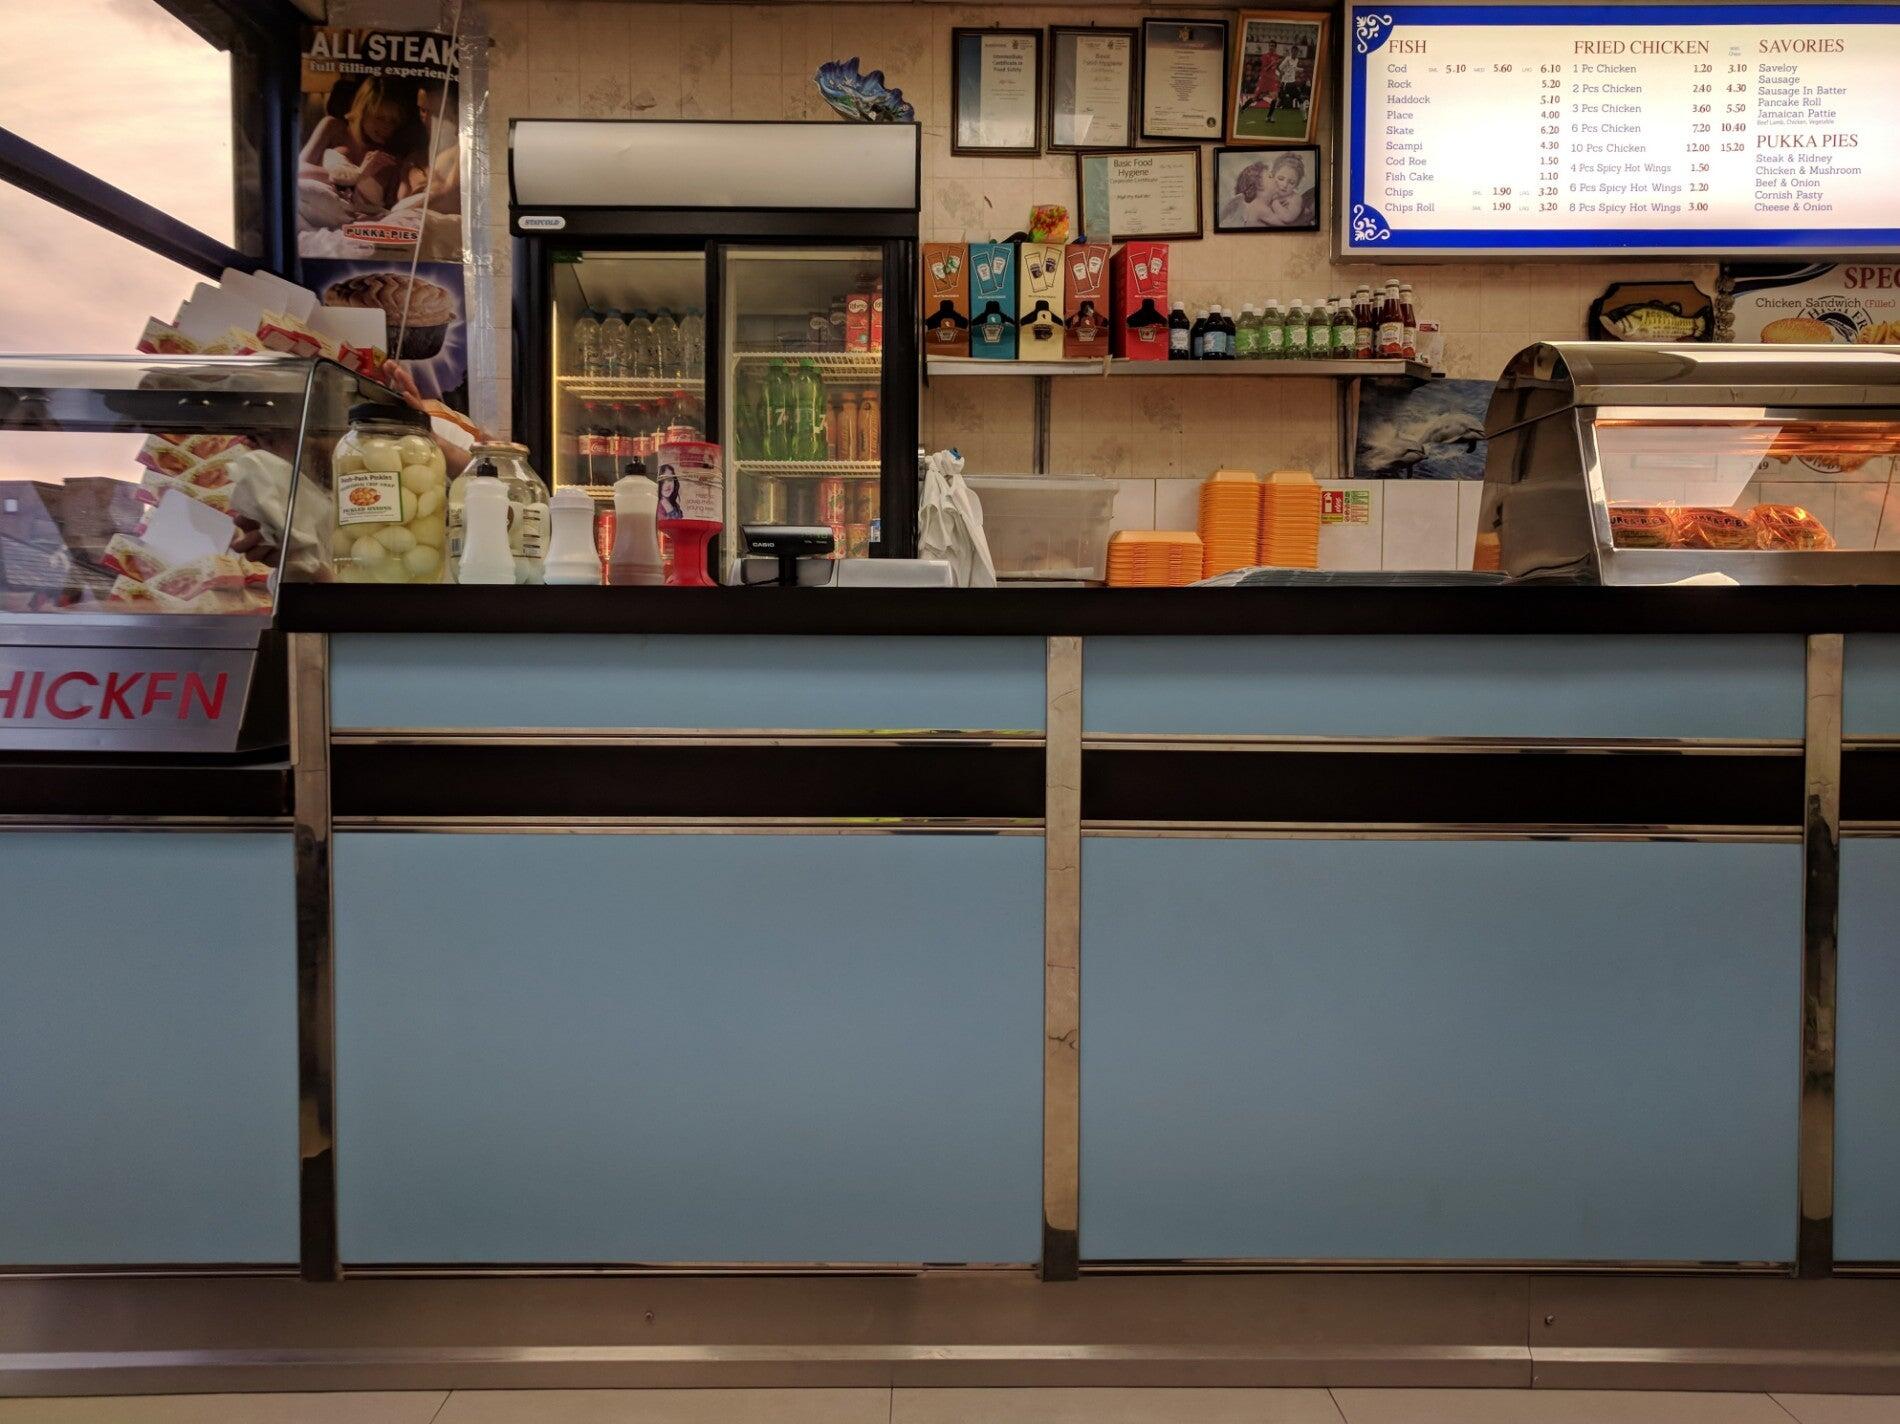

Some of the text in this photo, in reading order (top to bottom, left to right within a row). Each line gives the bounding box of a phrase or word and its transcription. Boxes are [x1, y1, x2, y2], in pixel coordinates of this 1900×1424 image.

[310, 32, 459, 68] ALL STEAK
[1388, 39, 1426, 53] FISH
[1575, 41, 1709, 54] FRIED CHICKEN
[1760, 39, 1844, 53] SAVORIES
[310, 60, 336, 72] full
[339, 62, 382, 77] filling
[1387, 64, 1407, 73] Cod
[1446, 64, 1466, 73] 5.10
[1494, 64, 1512, 72] 5.60
[1541, 64, 1560, 73] 6.10
[1574, 64, 1747, 73] 1 Pc Chicken 1.20 3.10
[1759, 64, 1798, 75] Saveloy
[1387, 79, 1560, 88] Rock 5.20
[1758, 75, 1800, 86] Sausage
[1573, 84, 1746, 93] 2 Pcs Chicken 2.40 4.30
[1758, 86, 1847, 97] Sausage In Batter
[1387, 95, 1560, 104] Haddock 5.10
[1758, 98, 1821, 107] Pancake Roll
[1573, 104, 1745, 113] 3 Pcs Chicken 3.60 5.50
[1387, 111, 1413, 119] Place
[1758, 109, 1836, 119] Jamaican Pattie
[1386, 126, 1560, 134] Skate 6.20
[1572, 124, 1578, 132] 6
[1581, 124, 1598, 133] Pcs
[1601, 124, 1640, 133] Chicken
[1692, 124, 1710, 133] 7.20
[1758, 134, 1858, 148] PUKKA PIES
[1385, 141, 1559, 152] Scampi 4.30
[1571, 143, 1744, 152] 10 Pcs Chicken 12.00 15.20
[1134, 158, 1153, 167] Food
[1385, 157, 1558, 166] Cod Roe 1.50
[1756, 154, 1832, 164] Steak & Kidney
[1579, 164, 1594, 172] Pcs
[1596, 164, 1622, 174] Spicy
[1624, 164, 1640, 172] Hot
[1644, 164, 1671, 174] Wings
[1692, 163, 1709, 172] 1.50
[1756, 166, 1861, 175] Chicken & Mushroom
[1118, 170, 1150, 178] Hygiene
[1385, 172, 1405, 181] Fish
[1409, 172, 1434, 181] Cake
[1756, 178, 1820, 187] Beef & Onion
[1385, 187, 1413, 198] Chips
[1494, 187, 1511, 196] 1.90
[1538, 187, 1558, 196] 3.20
[1570, 183, 1708, 194] 6 Pcs Spicy Hot Wings 2.20
[1755, 190, 1823, 202] Cornish Pasty
[1384, 203, 1413, 213] Chips
[1417, 203, 1434, 212] Roll
[1539, 203, 1558, 212] 3.20
[1569, 203, 1708, 214] 8 Pcs Spicy Hot Wings 3.00
[1754, 202, 1832, 212] Cheese & Onion
[346, 228, 418, 240] PUKKA-PIES
[1756, 297, 1896, 309] Chicken Sandwich (Fillet)
